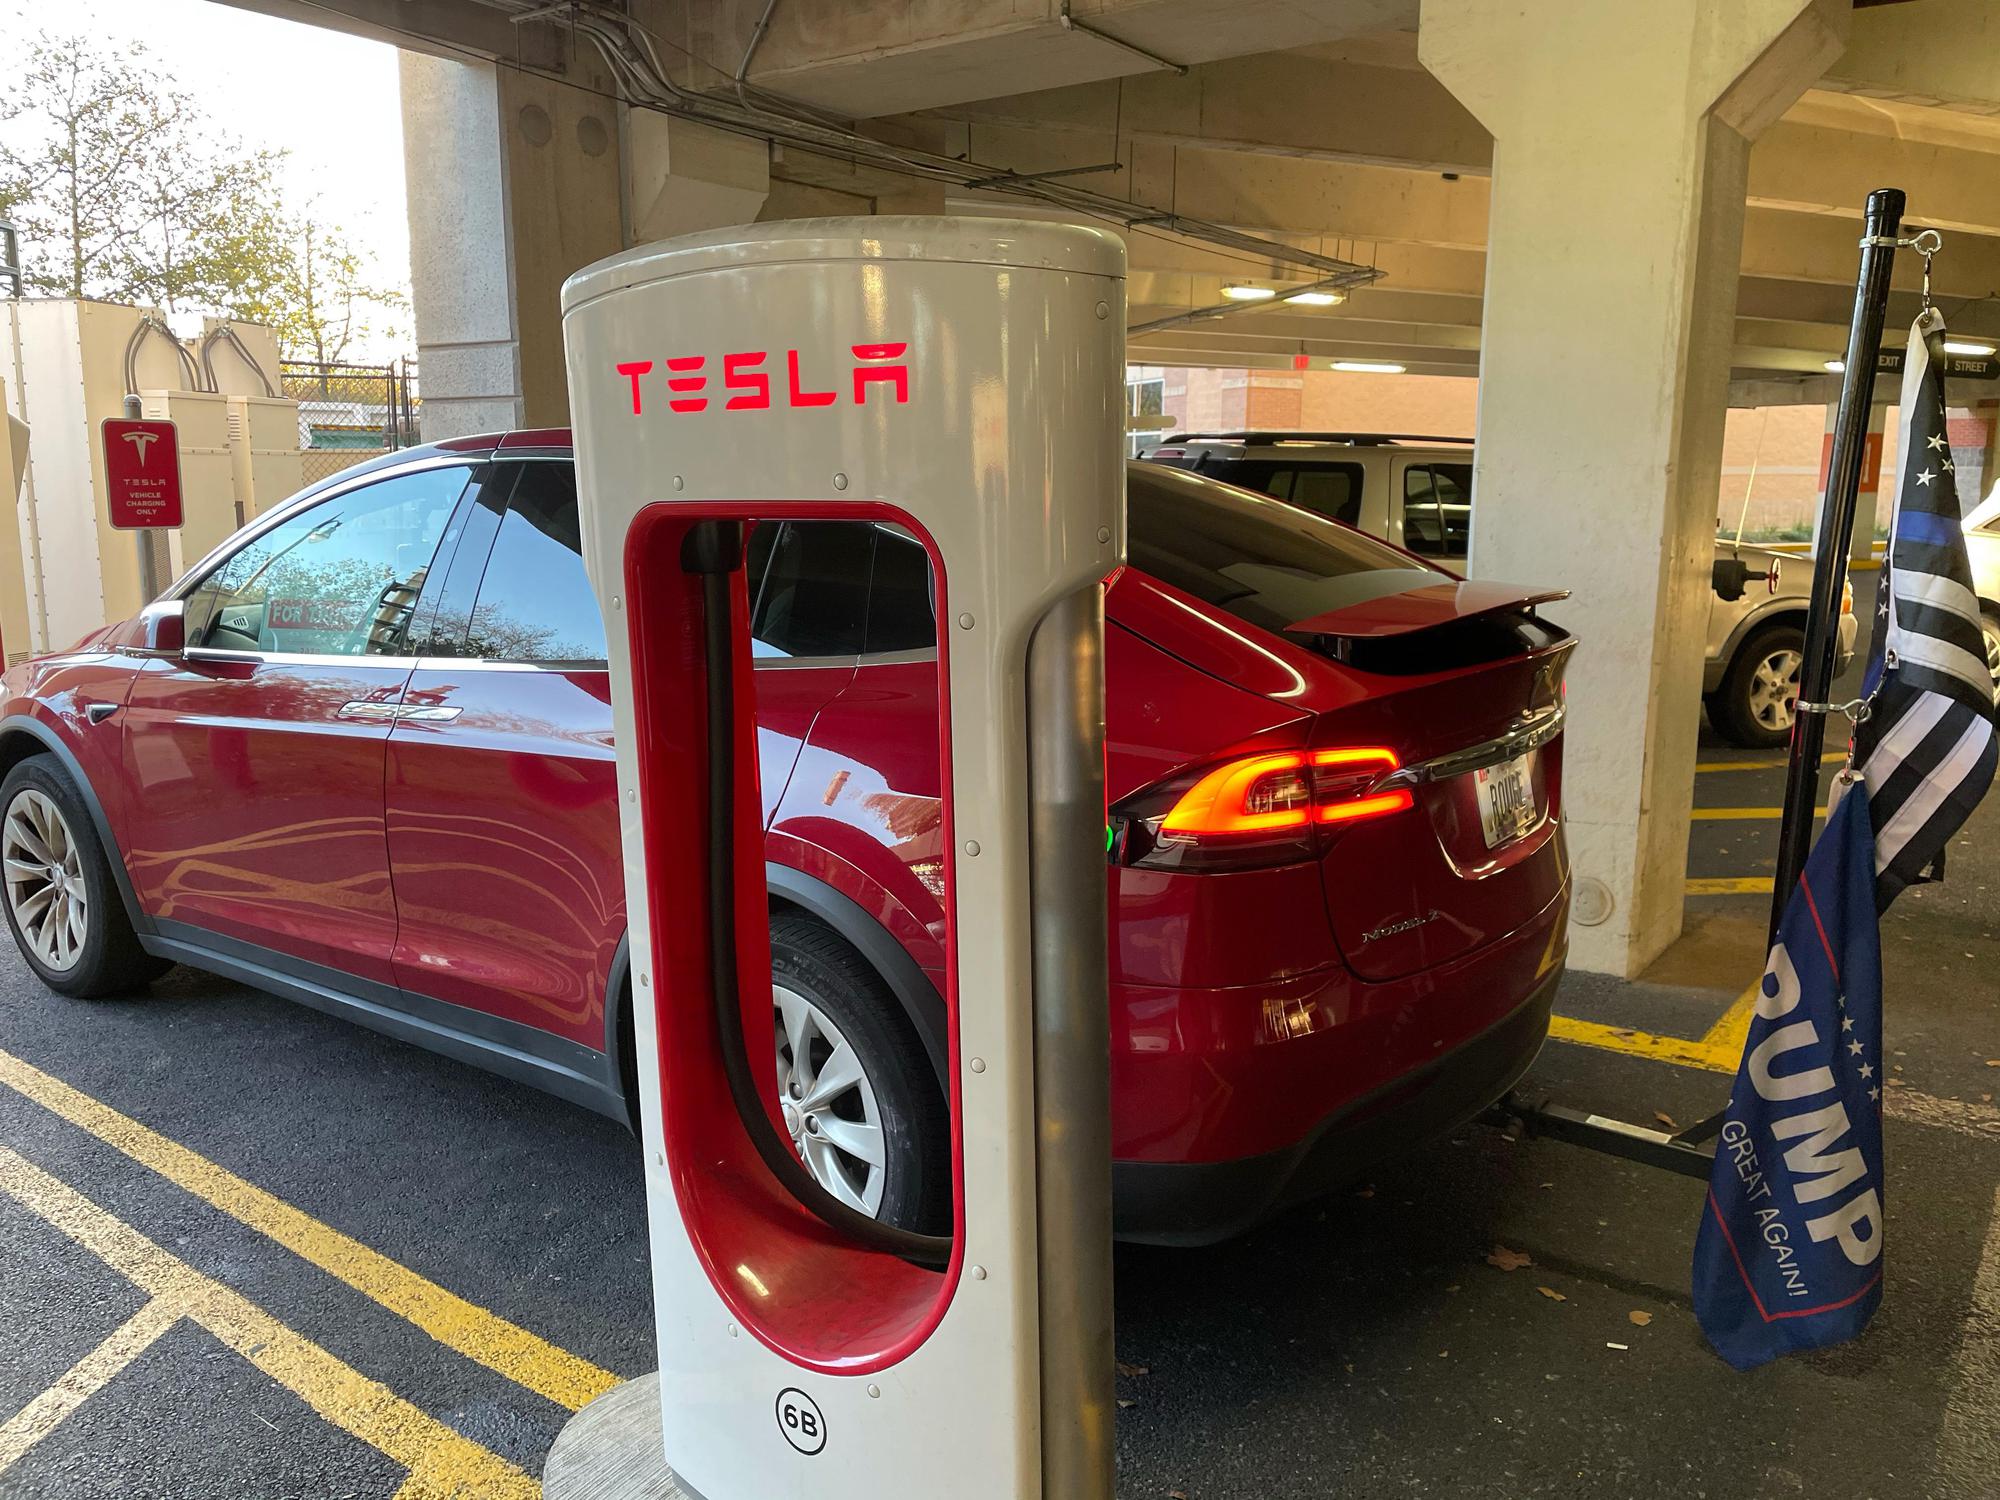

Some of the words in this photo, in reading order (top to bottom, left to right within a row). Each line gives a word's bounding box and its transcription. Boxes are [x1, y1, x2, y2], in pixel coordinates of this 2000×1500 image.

[1878, 355, 1900, 367] EXIT
[1954, 360, 1988, 373] STREET
[616, 342, 909, 415] TESLA
[123, 478, 166, 486] TESLA
[272, 605, 303, 623] FOR
[1721, 1120, 1772, 1201] GREAT
[1754, 1208, 1809, 1297] AGAIN!
[783, 1404, 818, 1437] 6B
